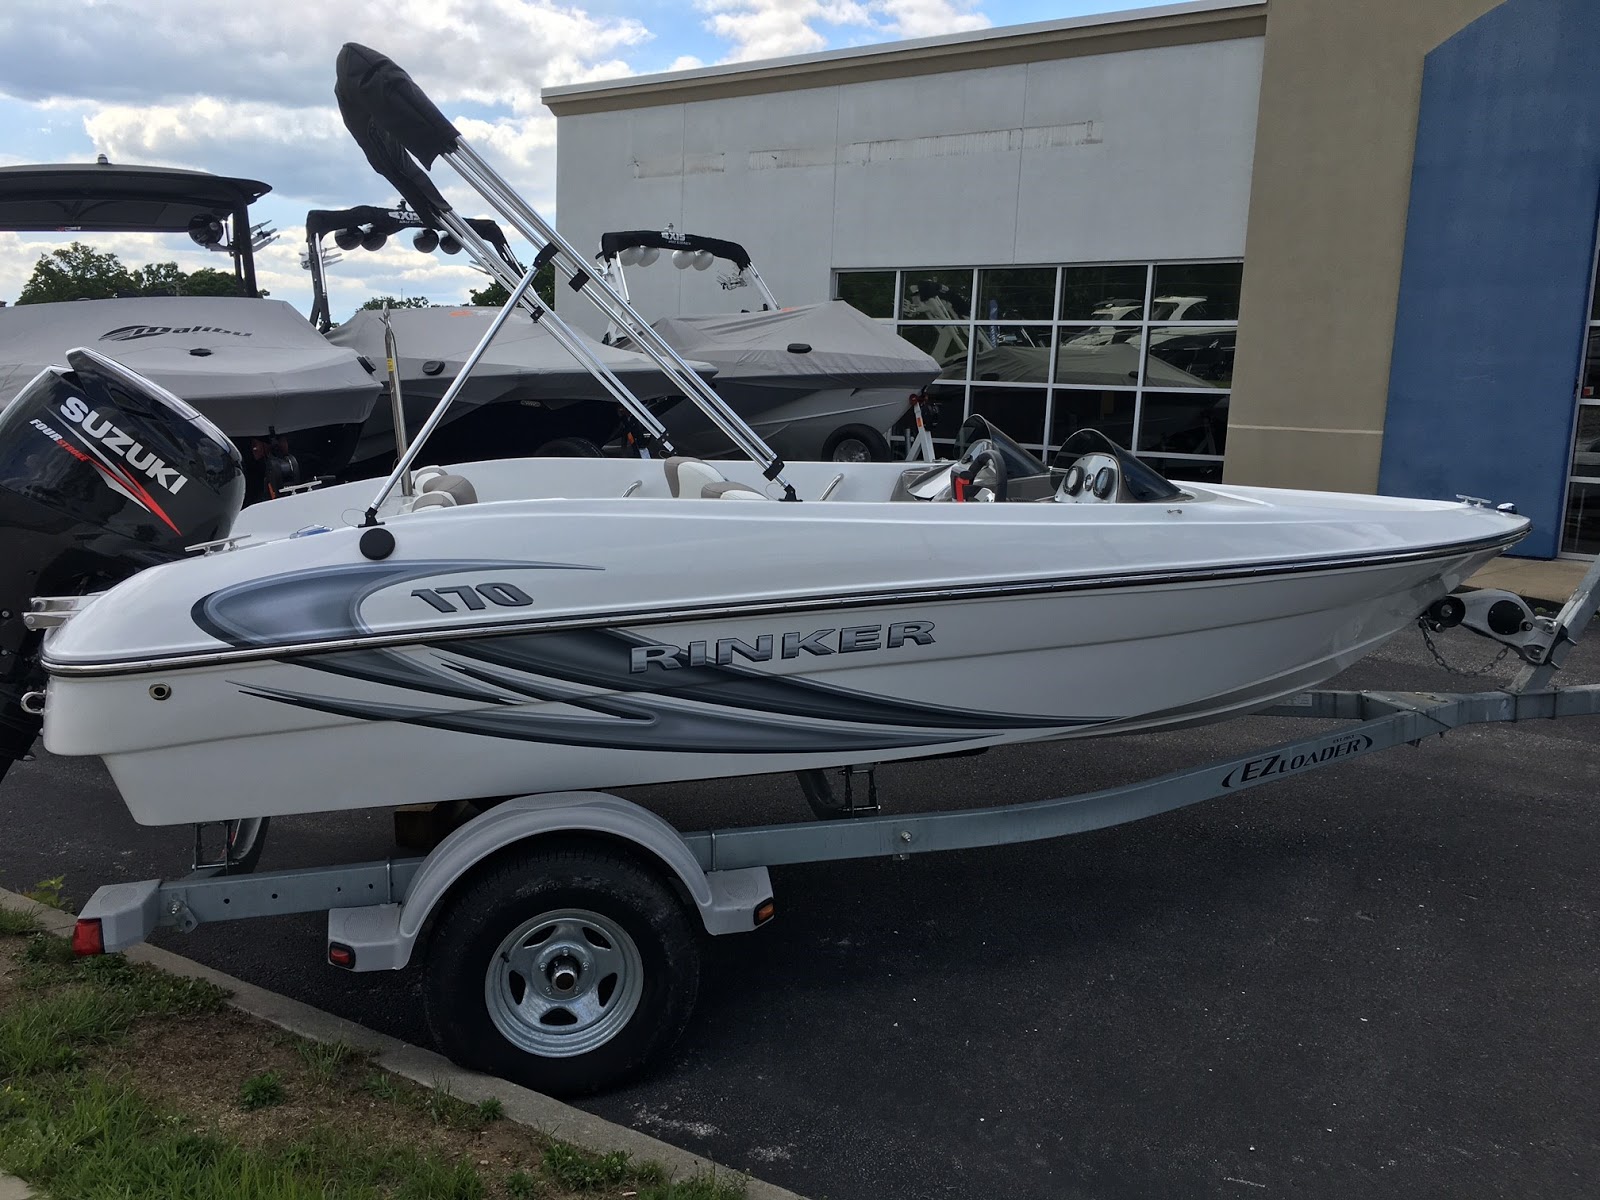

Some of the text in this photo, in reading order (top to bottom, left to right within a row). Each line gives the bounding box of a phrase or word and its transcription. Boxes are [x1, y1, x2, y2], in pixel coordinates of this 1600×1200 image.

[127, 325, 252, 338] Malibu
[60, 396, 188, 495] SUZUKI
[411, 582, 534, 613] 170
[629, 620, 936, 673] RINKER
